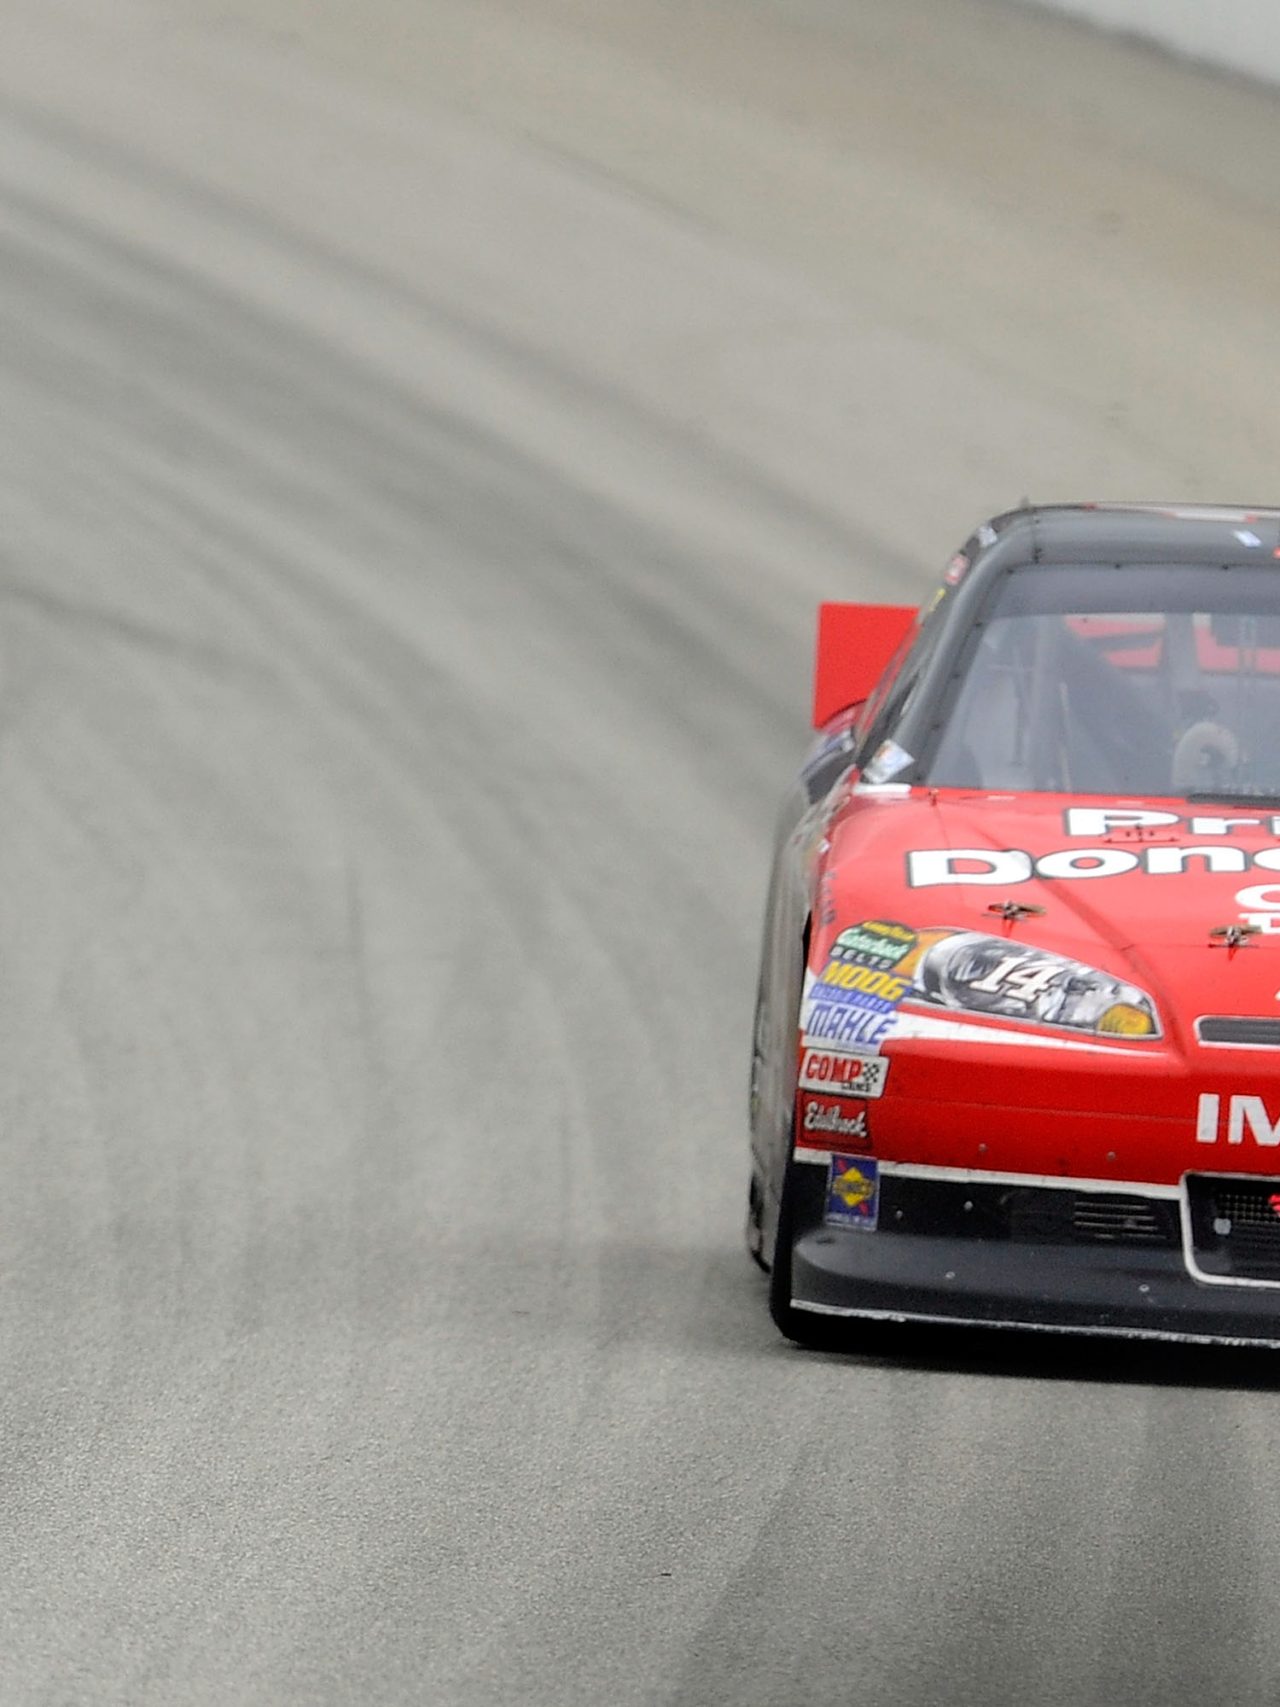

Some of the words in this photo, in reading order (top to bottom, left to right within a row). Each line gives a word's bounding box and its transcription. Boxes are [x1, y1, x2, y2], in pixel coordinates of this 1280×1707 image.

[823, 960, 913, 1002] MOOG
[968, 956, 1066, 1003] 14
[806, 1004, 898, 1045] MAHLE
[806, 1053, 864, 1084] COMP
